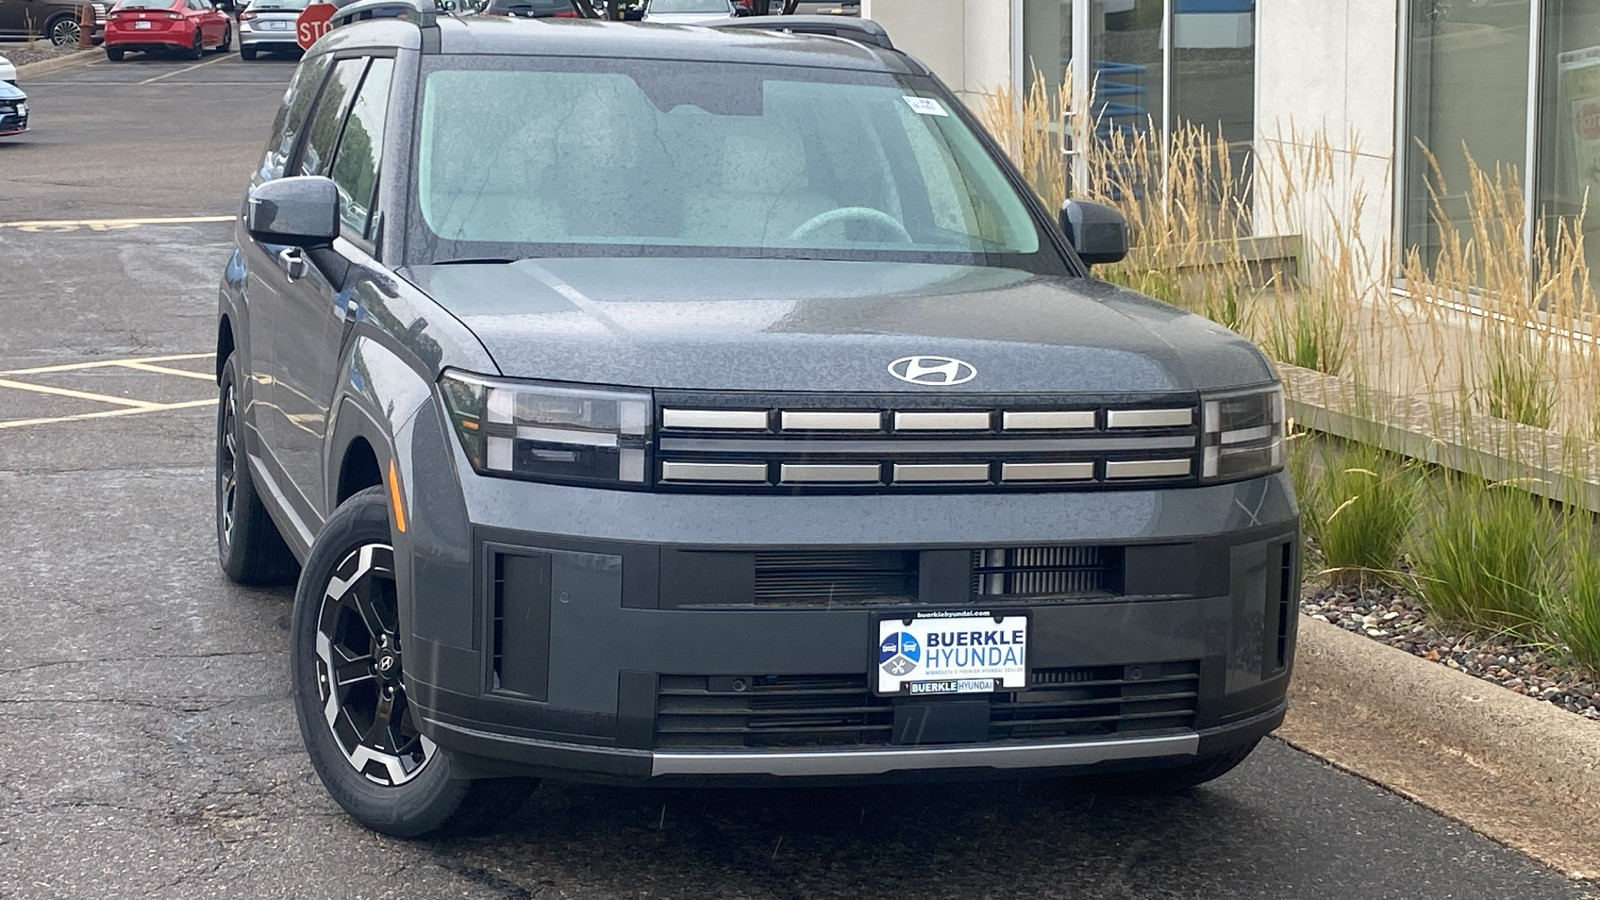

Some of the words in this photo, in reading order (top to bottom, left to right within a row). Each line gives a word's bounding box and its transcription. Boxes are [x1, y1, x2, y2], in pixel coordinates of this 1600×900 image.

[300, 21, 334, 42] STO
[927, 630, 1024, 647] BUERKLE
[926, 646, 1024, 668] HYUNDAI
[912, 682, 957, 693] BUERKLE
[959, 680, 993, 691] HYUNDAI
